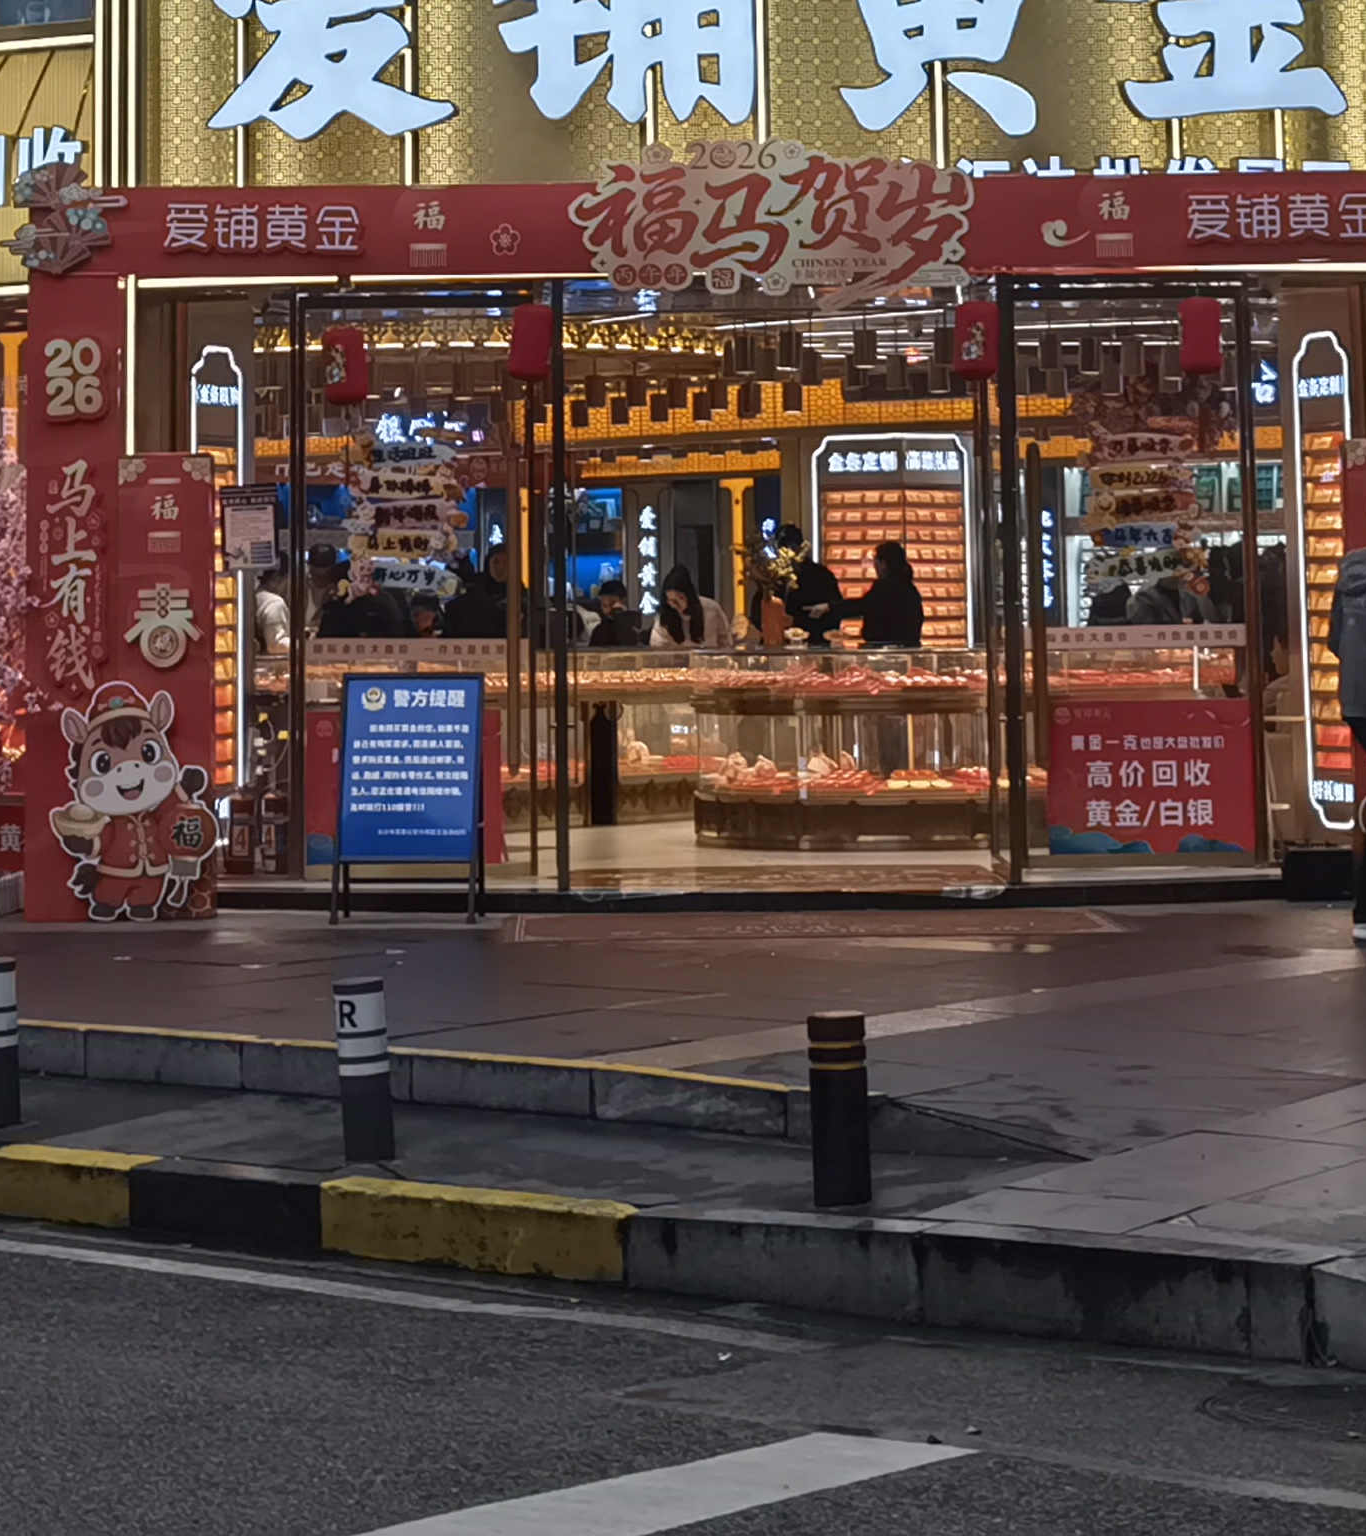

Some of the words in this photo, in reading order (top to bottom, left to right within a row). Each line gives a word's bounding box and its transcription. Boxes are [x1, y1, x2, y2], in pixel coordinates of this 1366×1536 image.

[412, 201, 446, 231] 福
[575, 155, 969, 279] 福马贺岁
[1098, 192, 1130, 222] 福
[165, 203, 361, 252] 爱铺黄金
[45, 337, 102, 378] 20
[46, 377, 103, 417] 26
[150, 494, 179, 521] 福
[39, 459, 97, 690] 马上有钱
[393, 689, 466, 709] 警方提醒
[1086, 759, 1212, 789] 高价回收
[1085, 798, 1214, 828] 黄金/白银
[170, 816, 204, 850] 福
[338, 1000, 358, 1029] R
